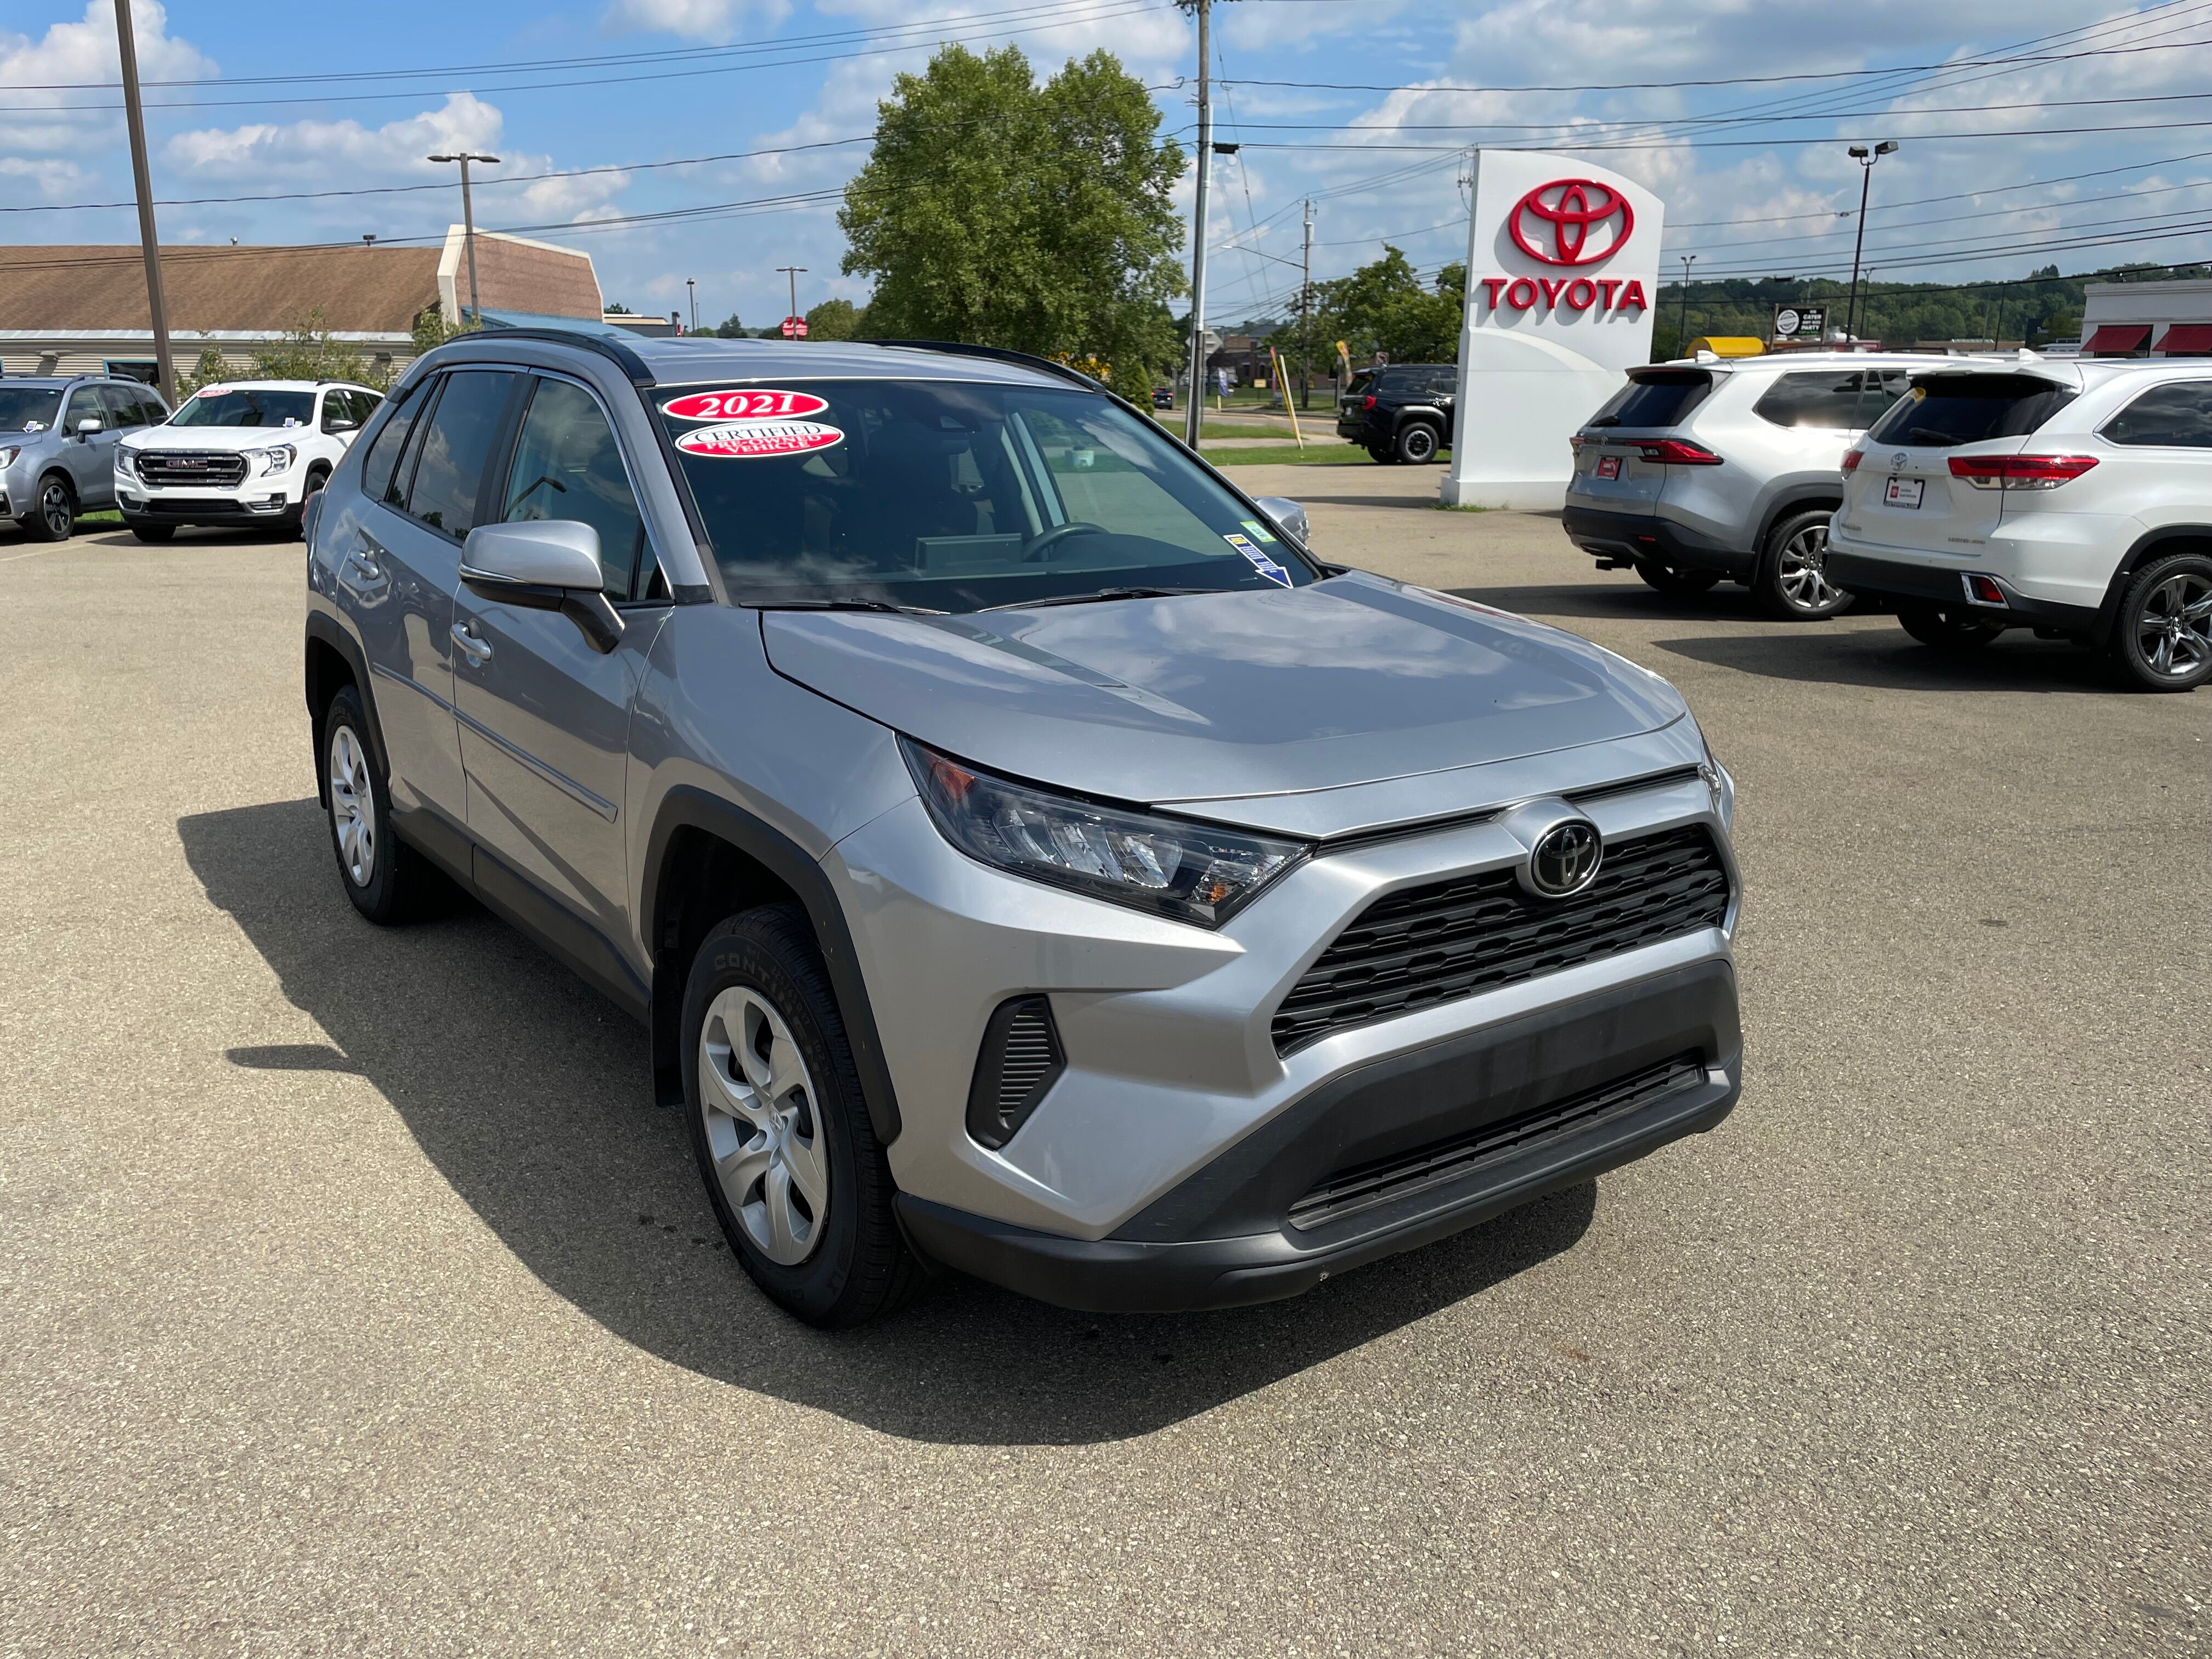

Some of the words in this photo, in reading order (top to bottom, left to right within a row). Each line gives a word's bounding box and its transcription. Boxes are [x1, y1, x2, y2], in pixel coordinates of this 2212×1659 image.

[1482, 277, 1647, 310] TOYOTA
[696, 394, 795, 417] 2021
[695, 425, 821, 443] CERTIFIED
[705, 435, 822, 450] PRE-OWNED
[727, 441, 811, 454] VEHICLE
[166, 459, 208, 469] GMC
